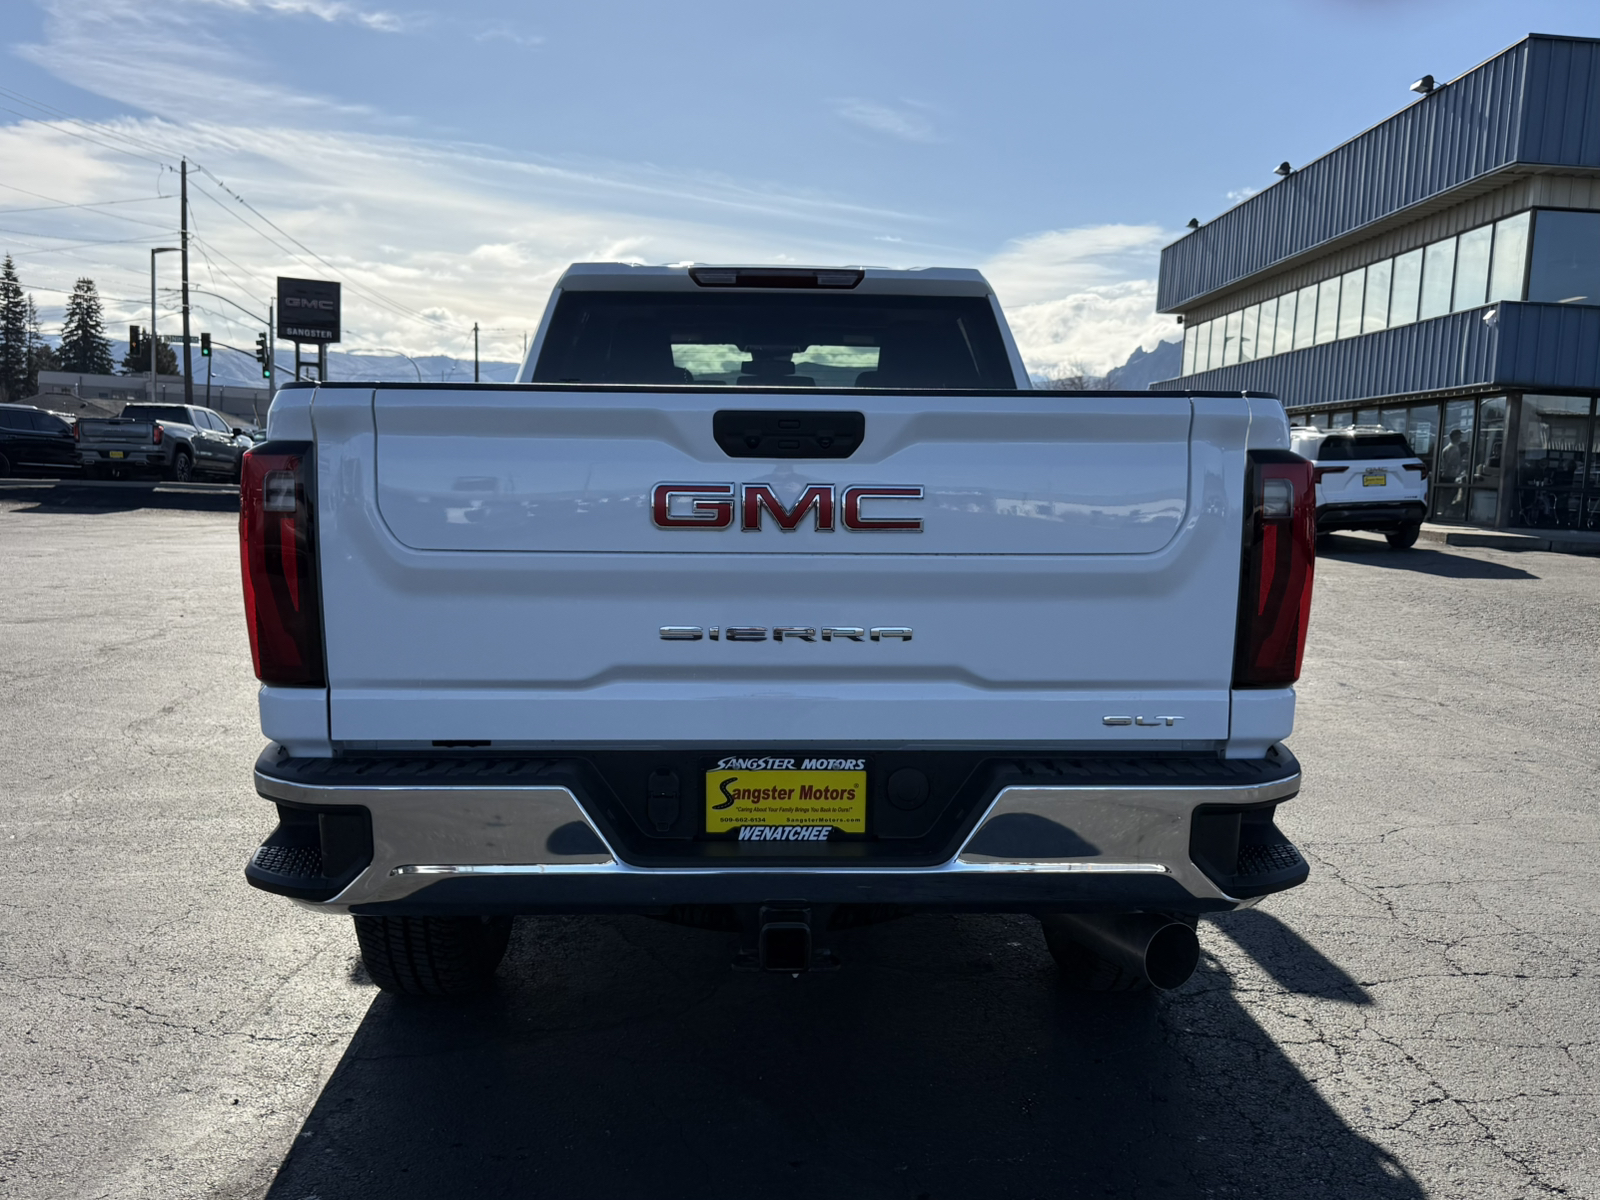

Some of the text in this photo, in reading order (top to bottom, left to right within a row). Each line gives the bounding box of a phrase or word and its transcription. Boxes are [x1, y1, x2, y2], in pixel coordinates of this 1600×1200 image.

[285, 297, 334, 310] GMC
[287, 327, 332, 339] SANGSTER
[650, 481, 925, 533] GMC
[659, 626, 913, 642] SIERRA
[1102, 715, 1185, 727] SLT
[707, 756, 866, 772] SANGSTER MOTORS
[712, 777, 795, 810] Sangster
[738, 826, 833, 841] WENATCHEE
